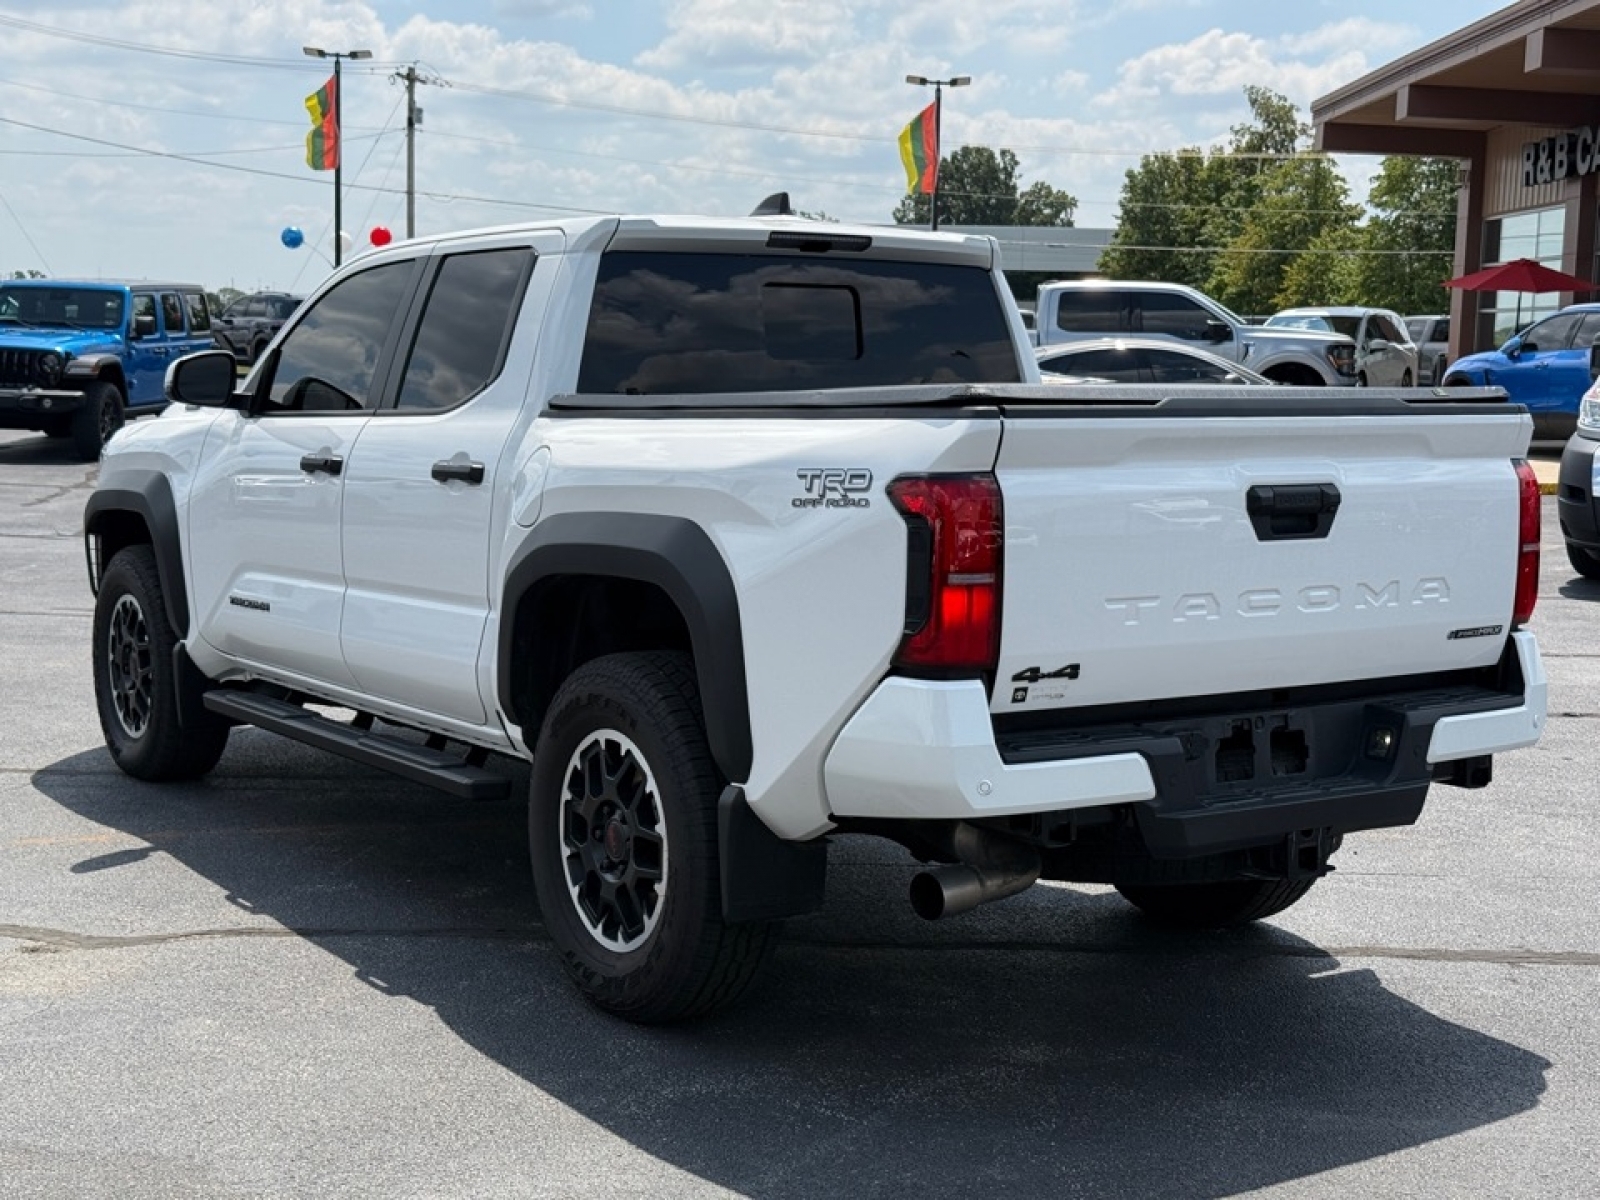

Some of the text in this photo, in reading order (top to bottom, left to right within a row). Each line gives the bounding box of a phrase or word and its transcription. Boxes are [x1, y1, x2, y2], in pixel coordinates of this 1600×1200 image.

[1522, 134, 1567, 187] R&B
[791, 498, 870, 508] OFF ROAD
[796, 468, 873, 500] TRD
[1104, 576, 1451, 626] TACOMA
